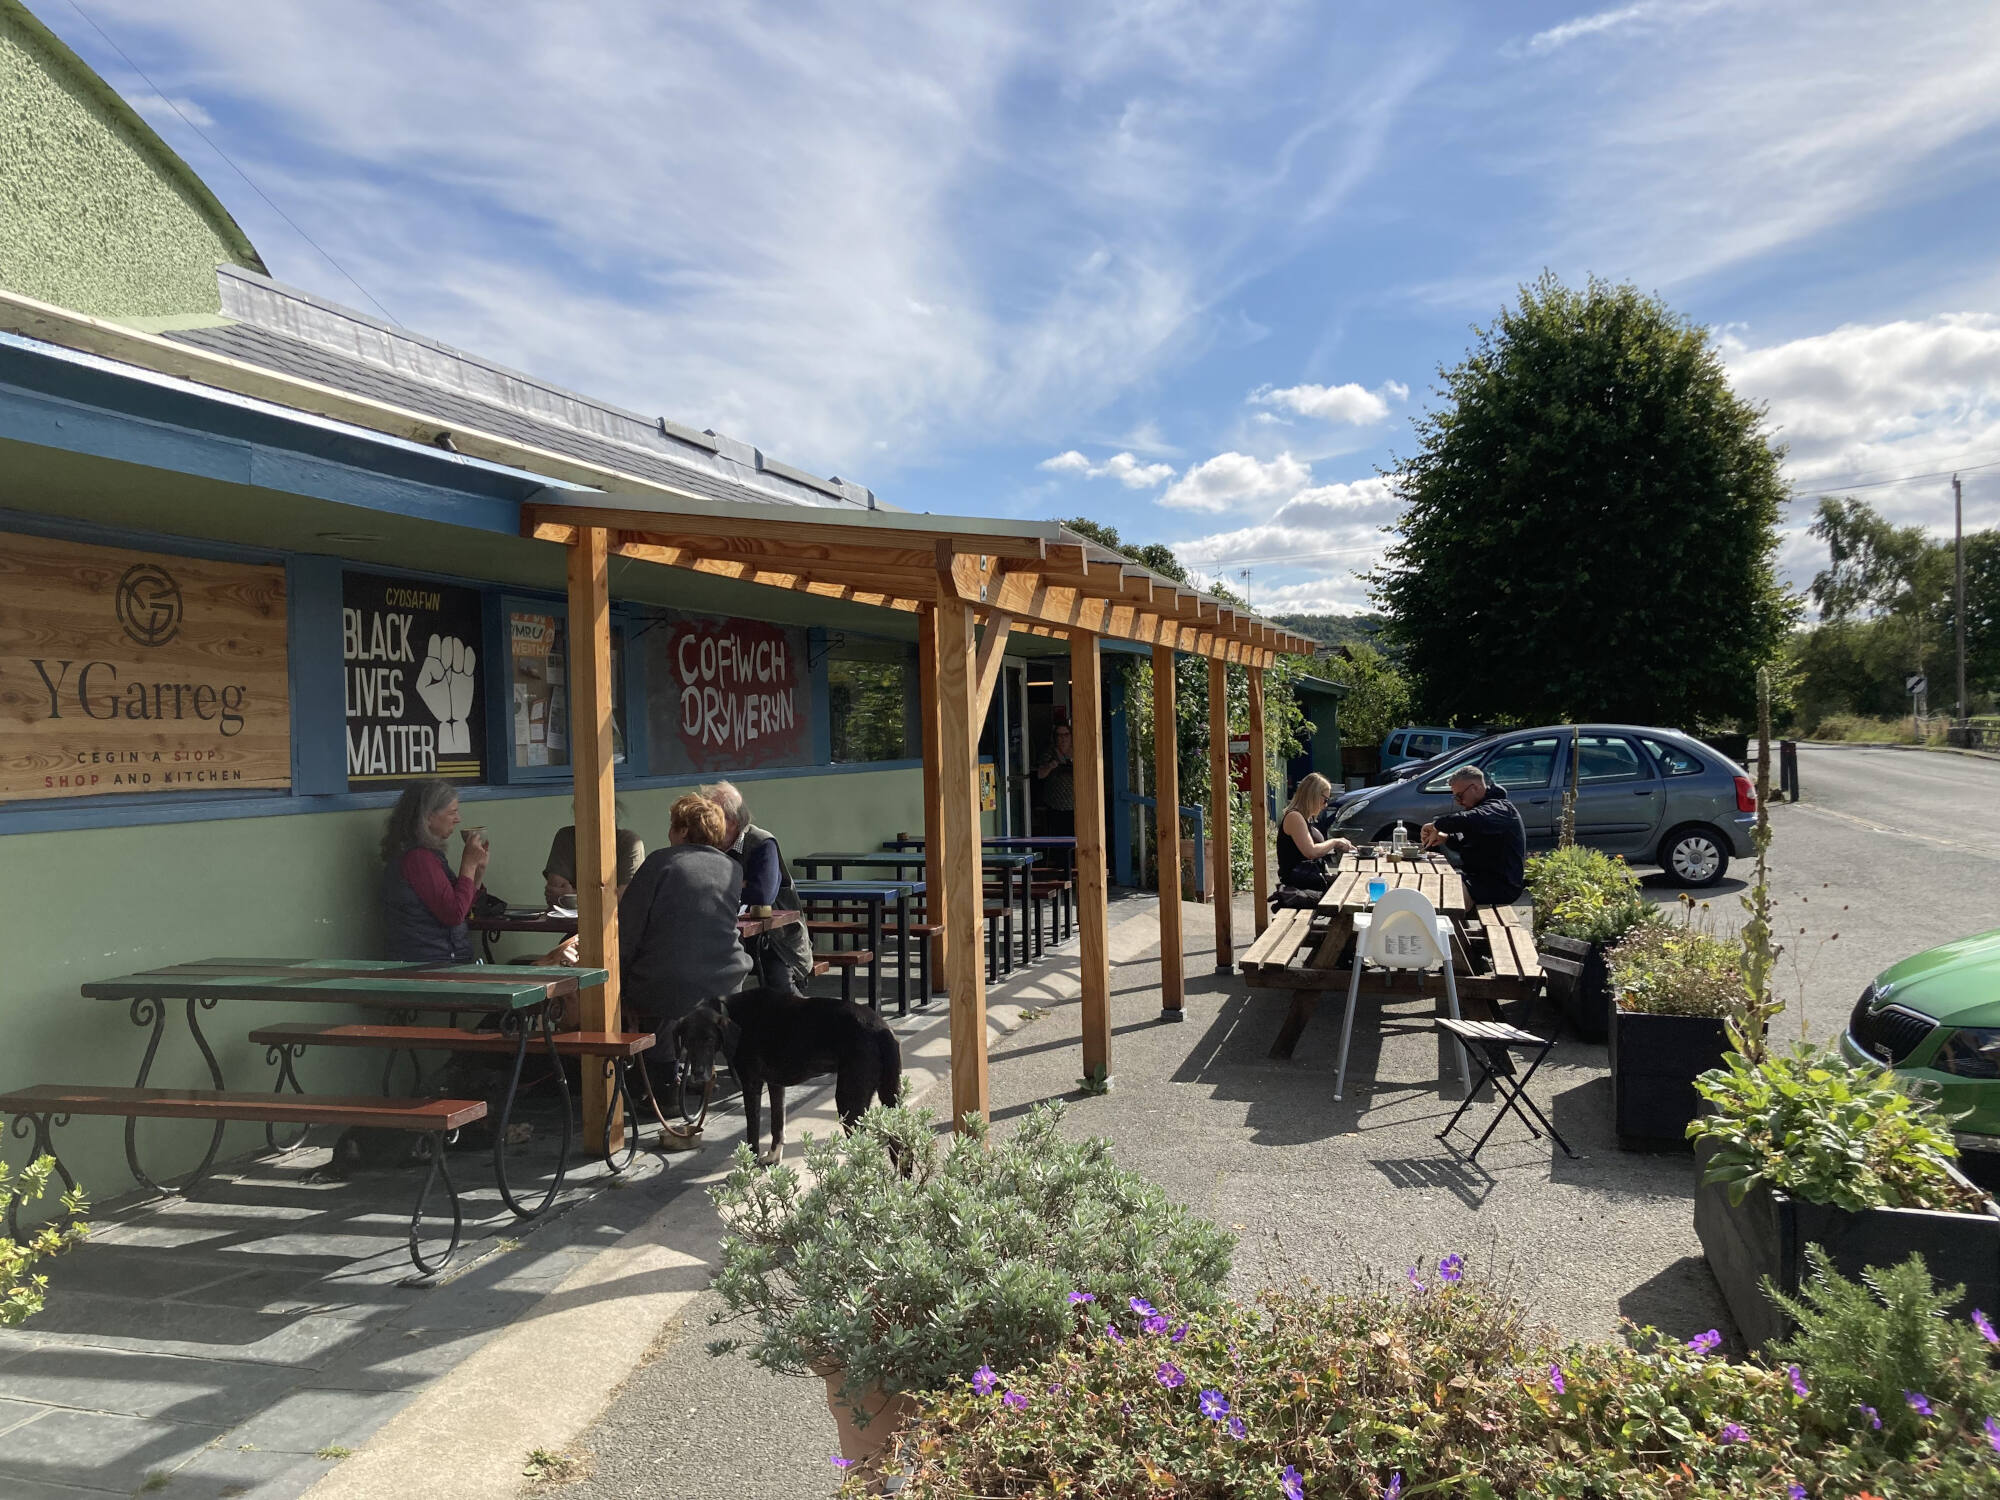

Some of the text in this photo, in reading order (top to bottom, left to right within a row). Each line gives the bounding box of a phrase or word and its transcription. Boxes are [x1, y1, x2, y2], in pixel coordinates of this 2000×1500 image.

[386, 587, 441, 612] CYDSAFWN
[343, 607, 415, 663] BLACK
[344, 666, 404, 719] LIVES
[77, 751, 216, 764] CEGIN A SIOP
[346, 724, 437, 775] MATTER
[45, 770, 242, 788] SHOP AND KITCHEN
